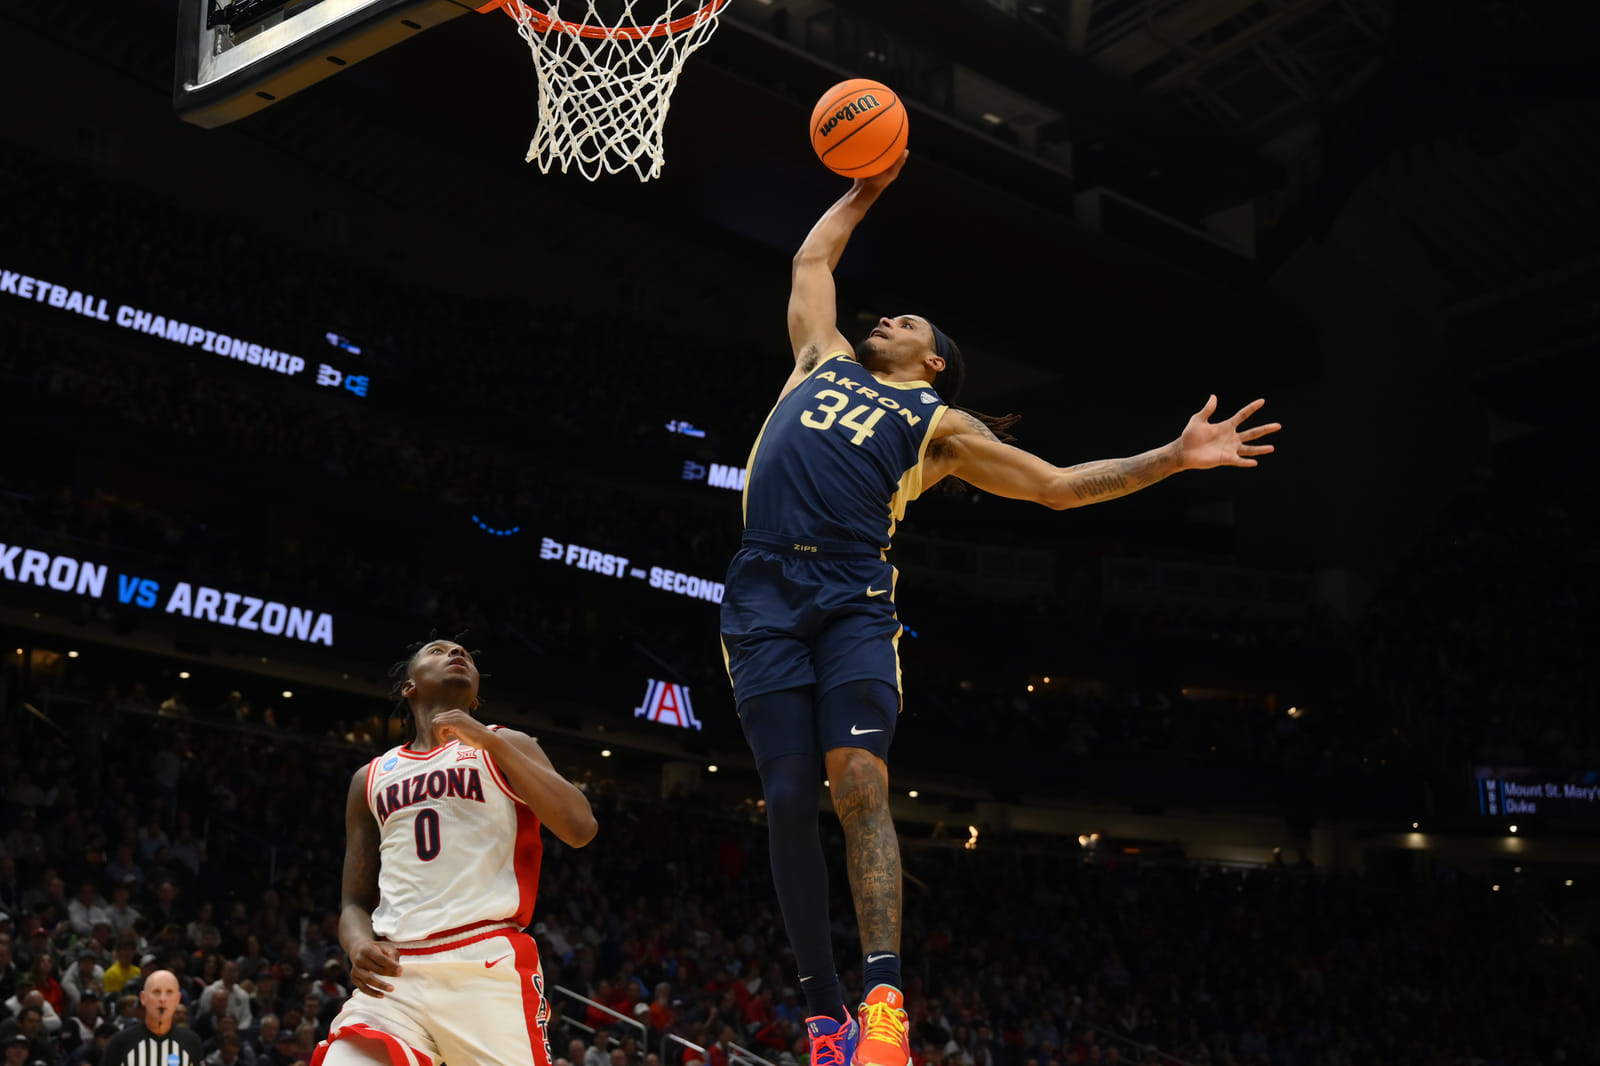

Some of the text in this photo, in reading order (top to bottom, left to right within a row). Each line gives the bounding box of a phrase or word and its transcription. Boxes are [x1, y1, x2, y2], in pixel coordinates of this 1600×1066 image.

[820, 94, 880, 137] Wilson
[0, 267, 305, 376] KETBALL CHAMPIONSHIP
[800, 389, 887, 447] 34
[814, 370, 922, 427] AKRON
[565, 543, 630, 579] FIRST
[648, 565, 725, 604] SECOND
[793, 543, 818, 553] ZIPS
[0, 542, 334, 647] KRON VS ARIZONA
[376, 767, 486, 827] ARIZONA
[1504, 781, 1543, 798] Mount
[1506, 797, 1537, 814] Duke
[414, 807, 441, 862] 0
